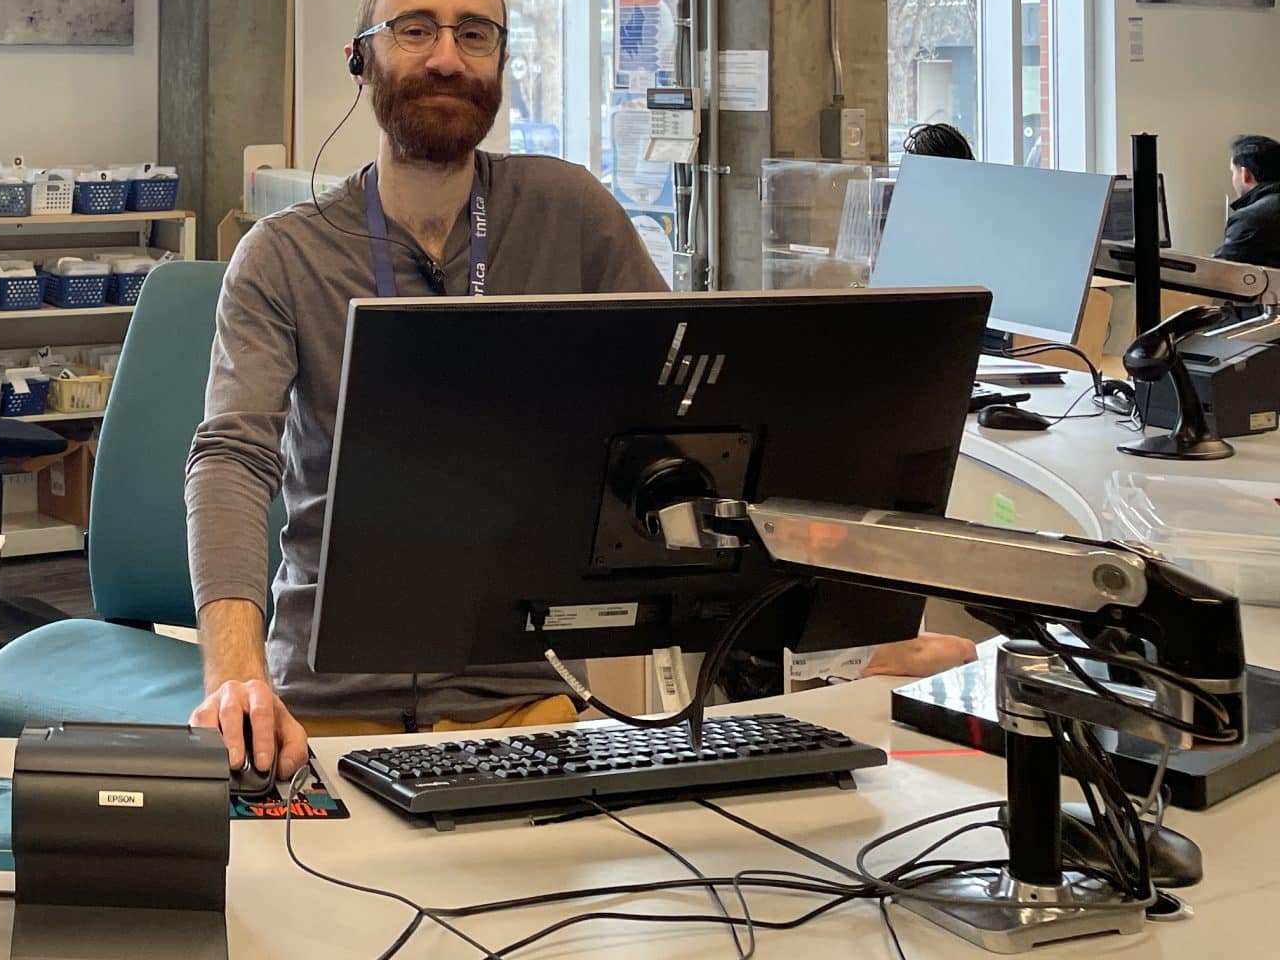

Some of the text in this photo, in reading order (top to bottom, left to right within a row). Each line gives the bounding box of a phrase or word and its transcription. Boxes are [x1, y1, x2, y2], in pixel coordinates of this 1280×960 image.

[144, 164, 151, 173] P
[472, 195, 487, 238] tnrl.ca
[38, 348, 49, 358] W
[107, 794, 135, 803] EPSON
